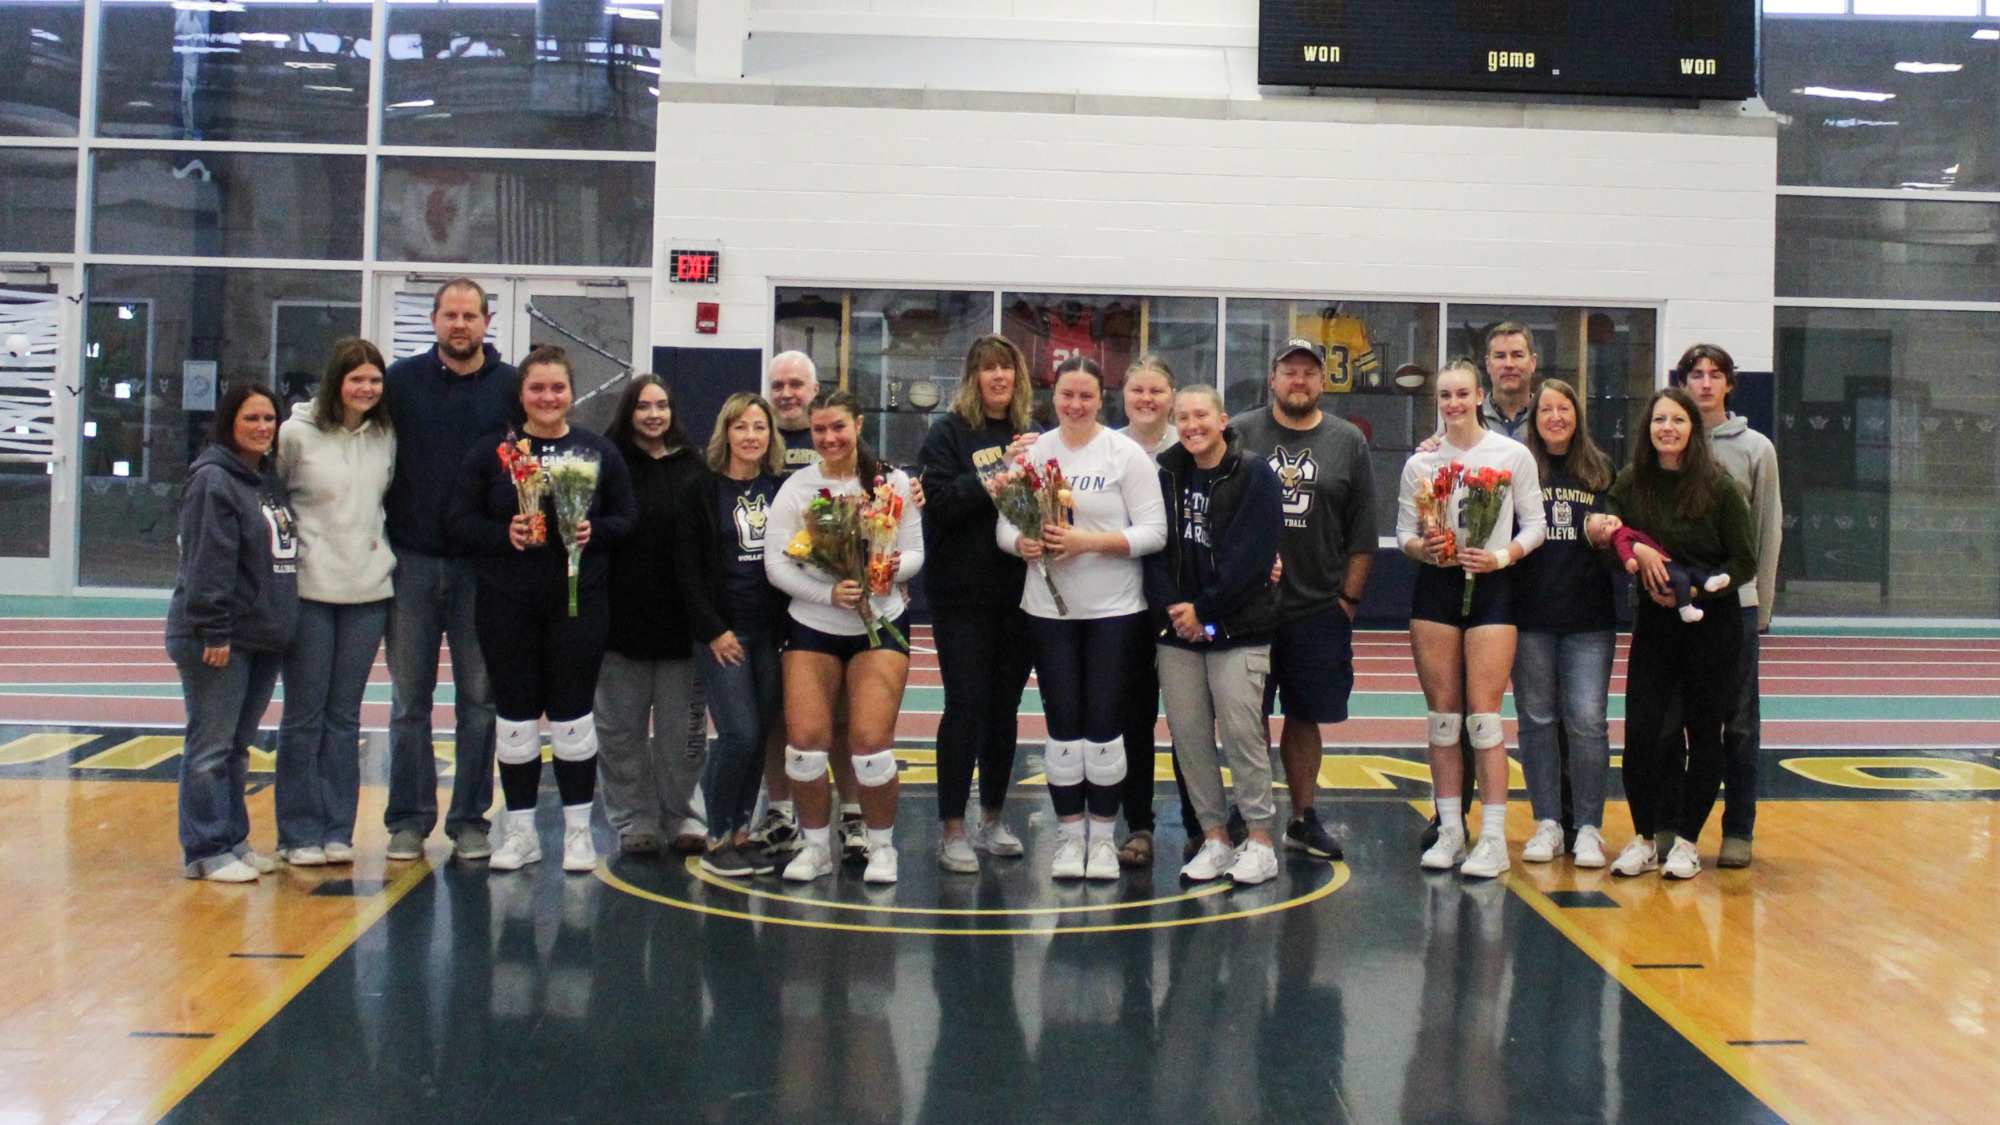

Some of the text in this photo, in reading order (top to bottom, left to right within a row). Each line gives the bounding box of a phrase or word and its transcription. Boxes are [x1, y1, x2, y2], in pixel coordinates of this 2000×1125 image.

[1303, 45, 1341, 63] won
[1487, 50, 1536, 72] game
[1680, 58, 1716, 75] won
[677, 254, 713, 279] EXIT
[1555, 487, 1595, 506] CANTON
